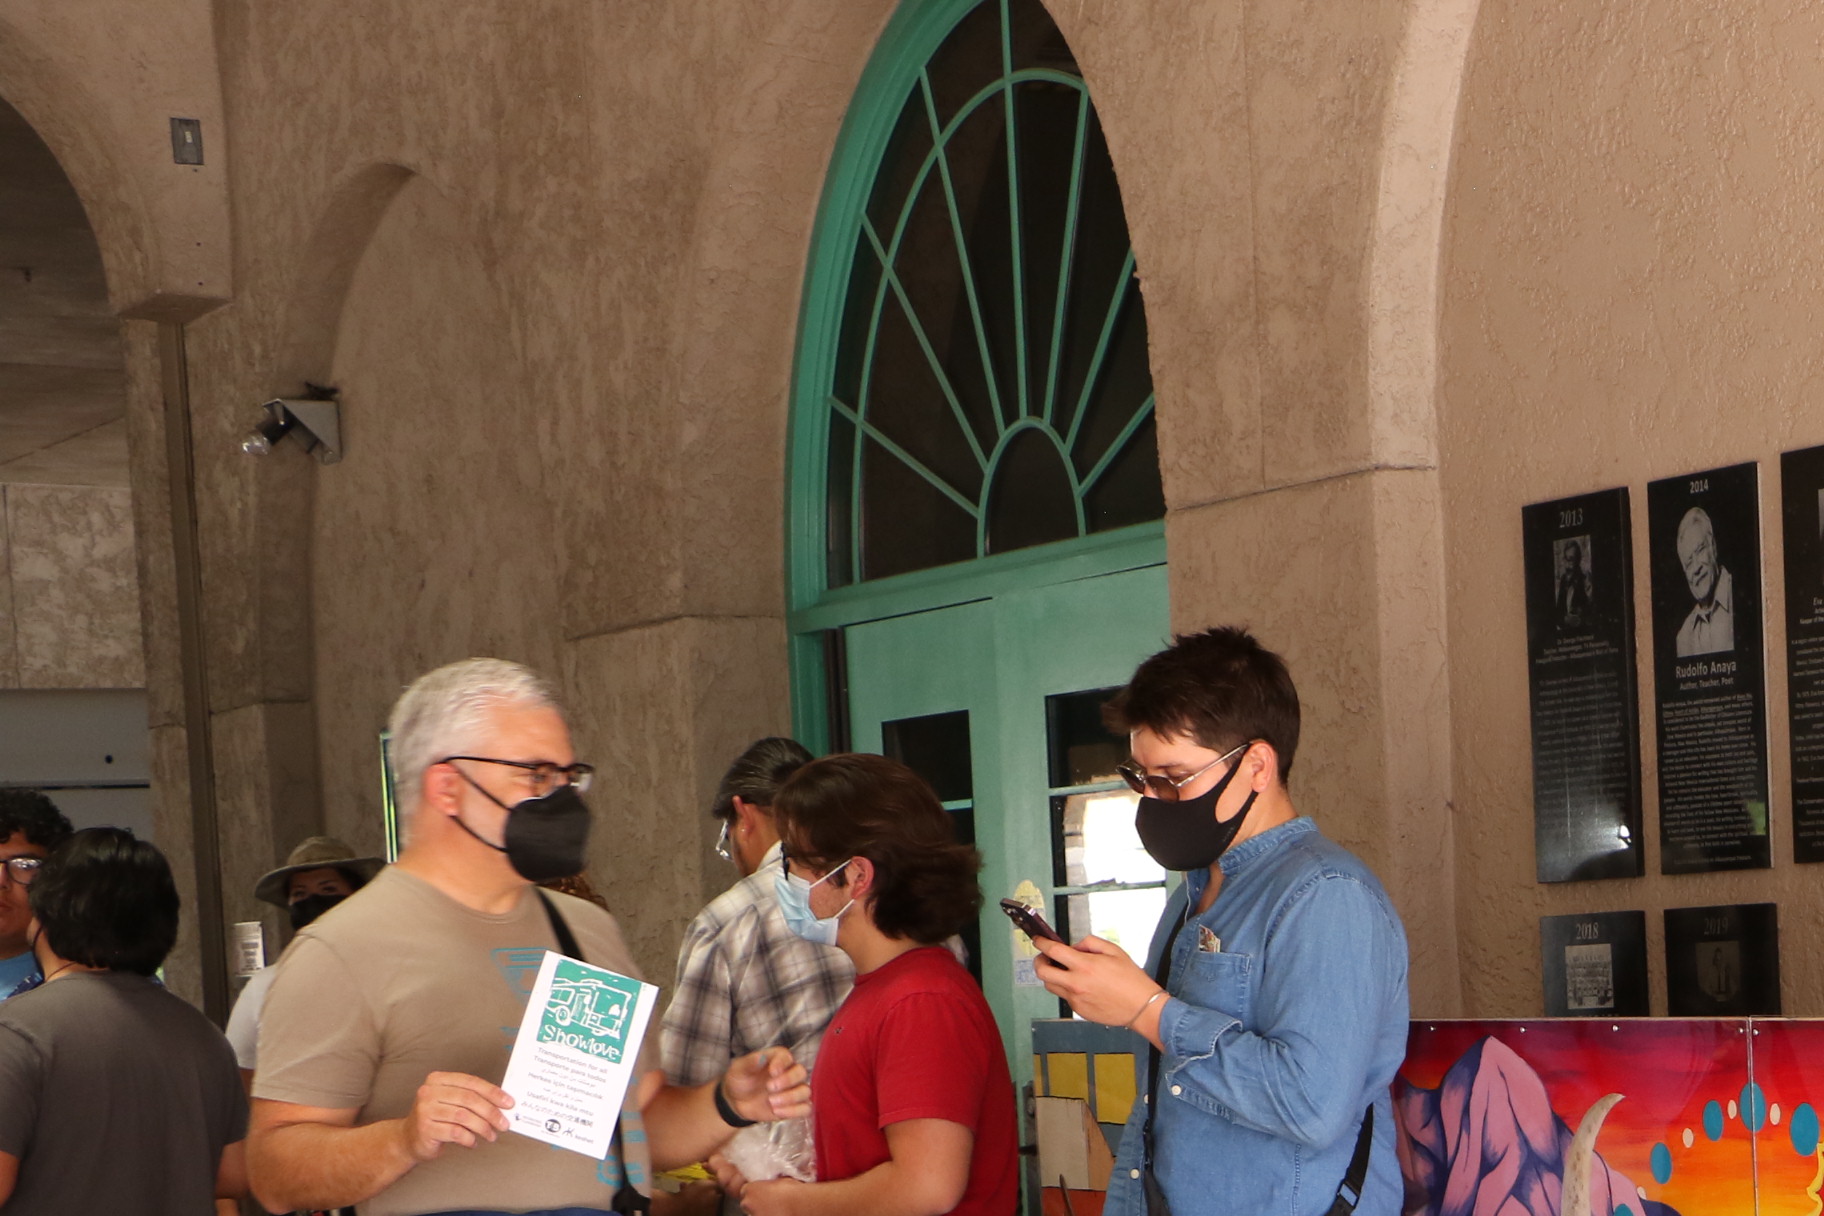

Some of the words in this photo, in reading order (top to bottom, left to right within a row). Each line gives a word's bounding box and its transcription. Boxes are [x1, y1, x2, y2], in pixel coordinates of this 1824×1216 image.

[1689, 479, 1709, 495] 2014
[1559, 509, 1584, 529] 2013
[1676, 663, 1708, 679] Rudolfo
[1711, 659, 1737, 674] Anaya
[1576, 922, 1599, 940] 2018
[1704, 917, 1729, 936] 2019
